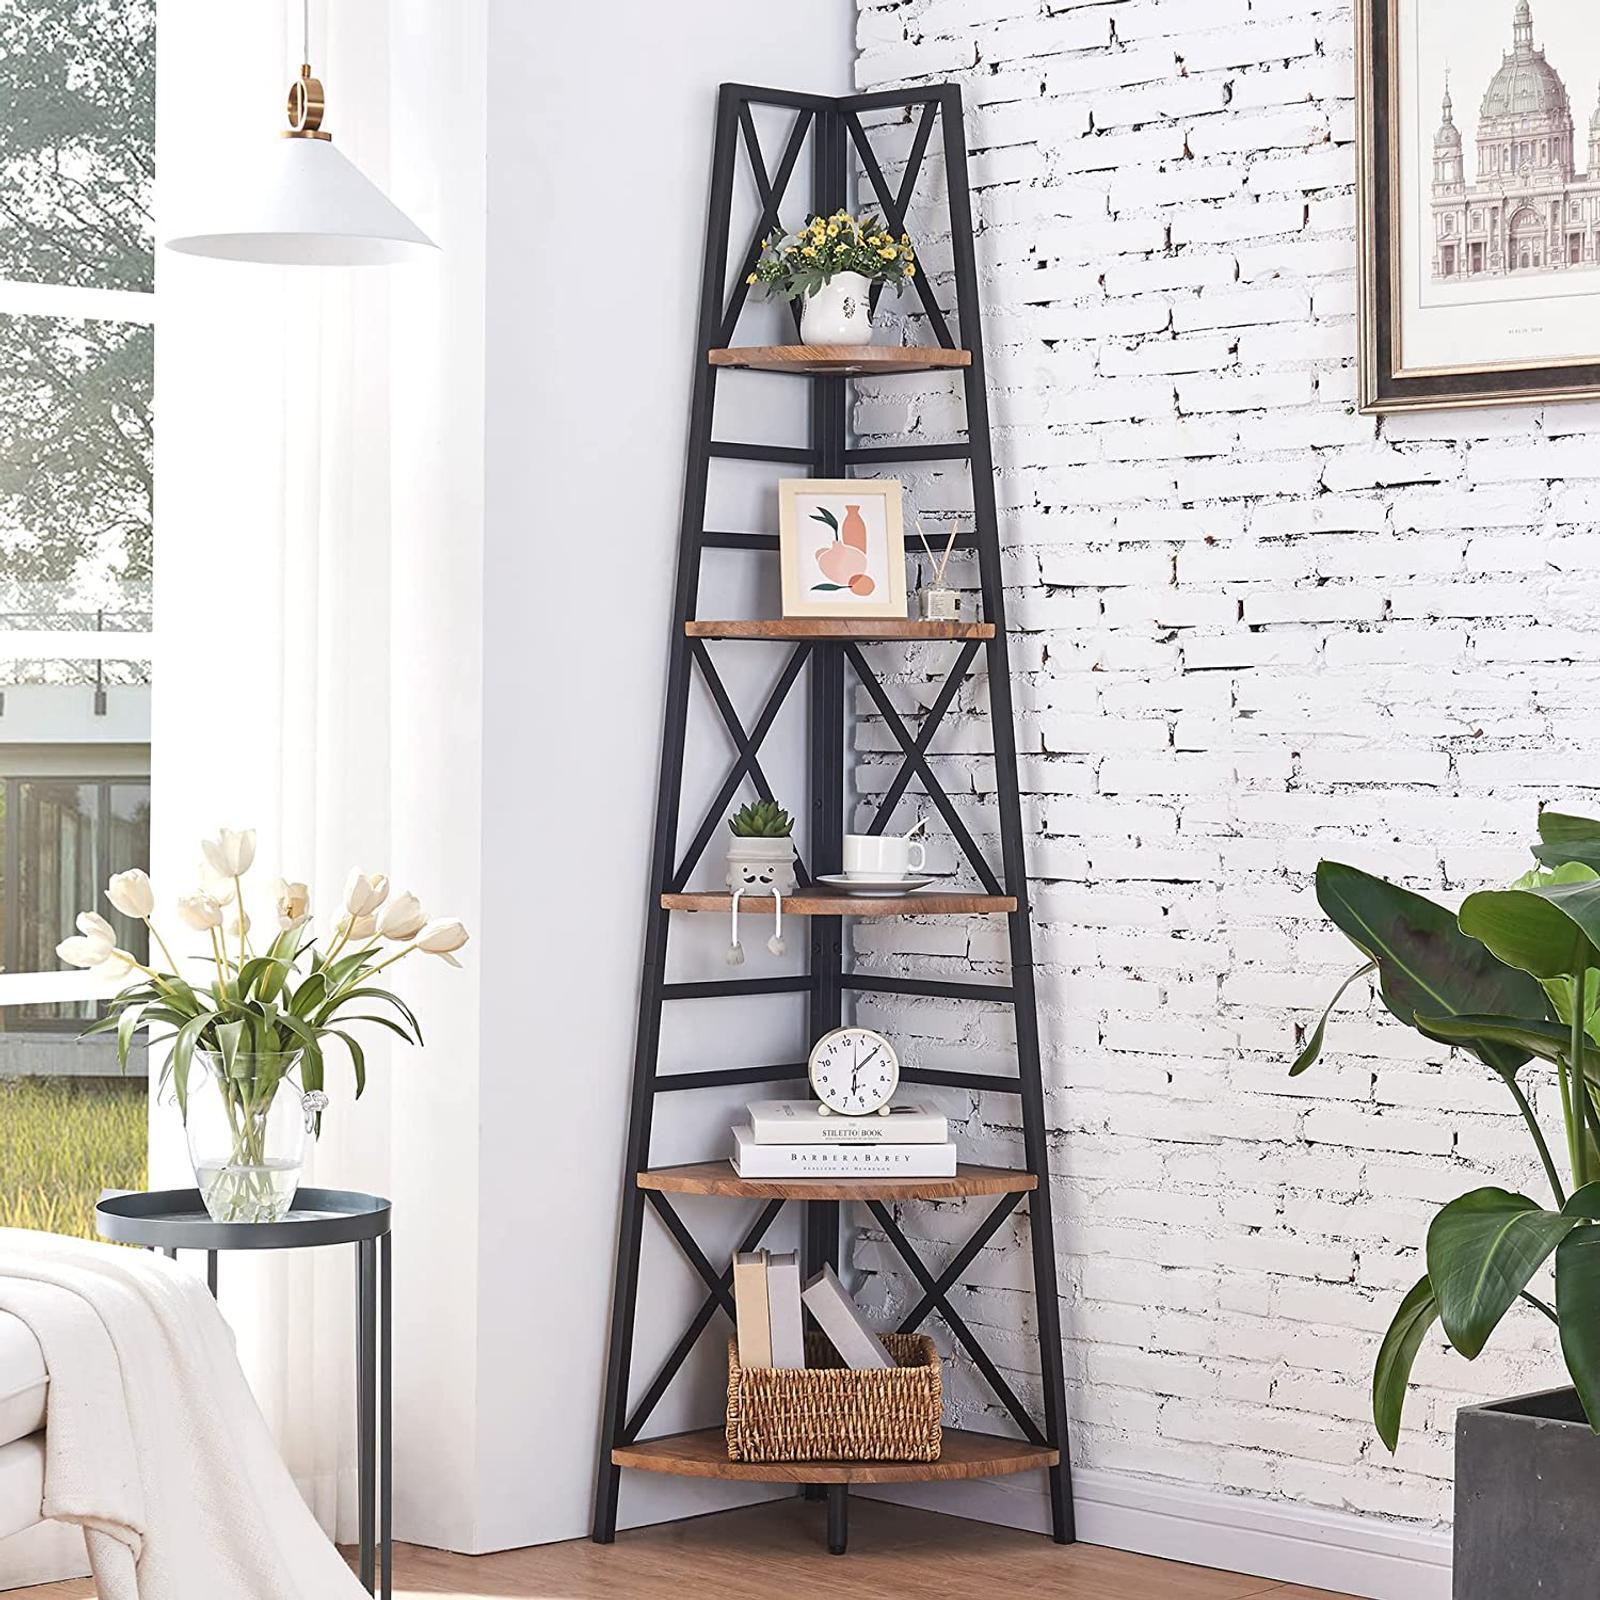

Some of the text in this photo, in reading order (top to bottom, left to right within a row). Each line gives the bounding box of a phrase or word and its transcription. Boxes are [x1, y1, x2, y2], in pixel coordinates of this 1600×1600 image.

[842, 1039, 852, 1047] 12
[828, 1047, 838, 1055] 11
[821, 1059, 831, 1067] 10
[822, 1075, 828, 1083] 9
[830, 1088, 836, 1096] 8
[872, 1088, 879, 1096] 5
[843, 1096, 849, 1104] 7
[822, 1129, 883, 1137] STILETTO BOOK
[791, 1152, 911, 1162] BARBERA BAREY
